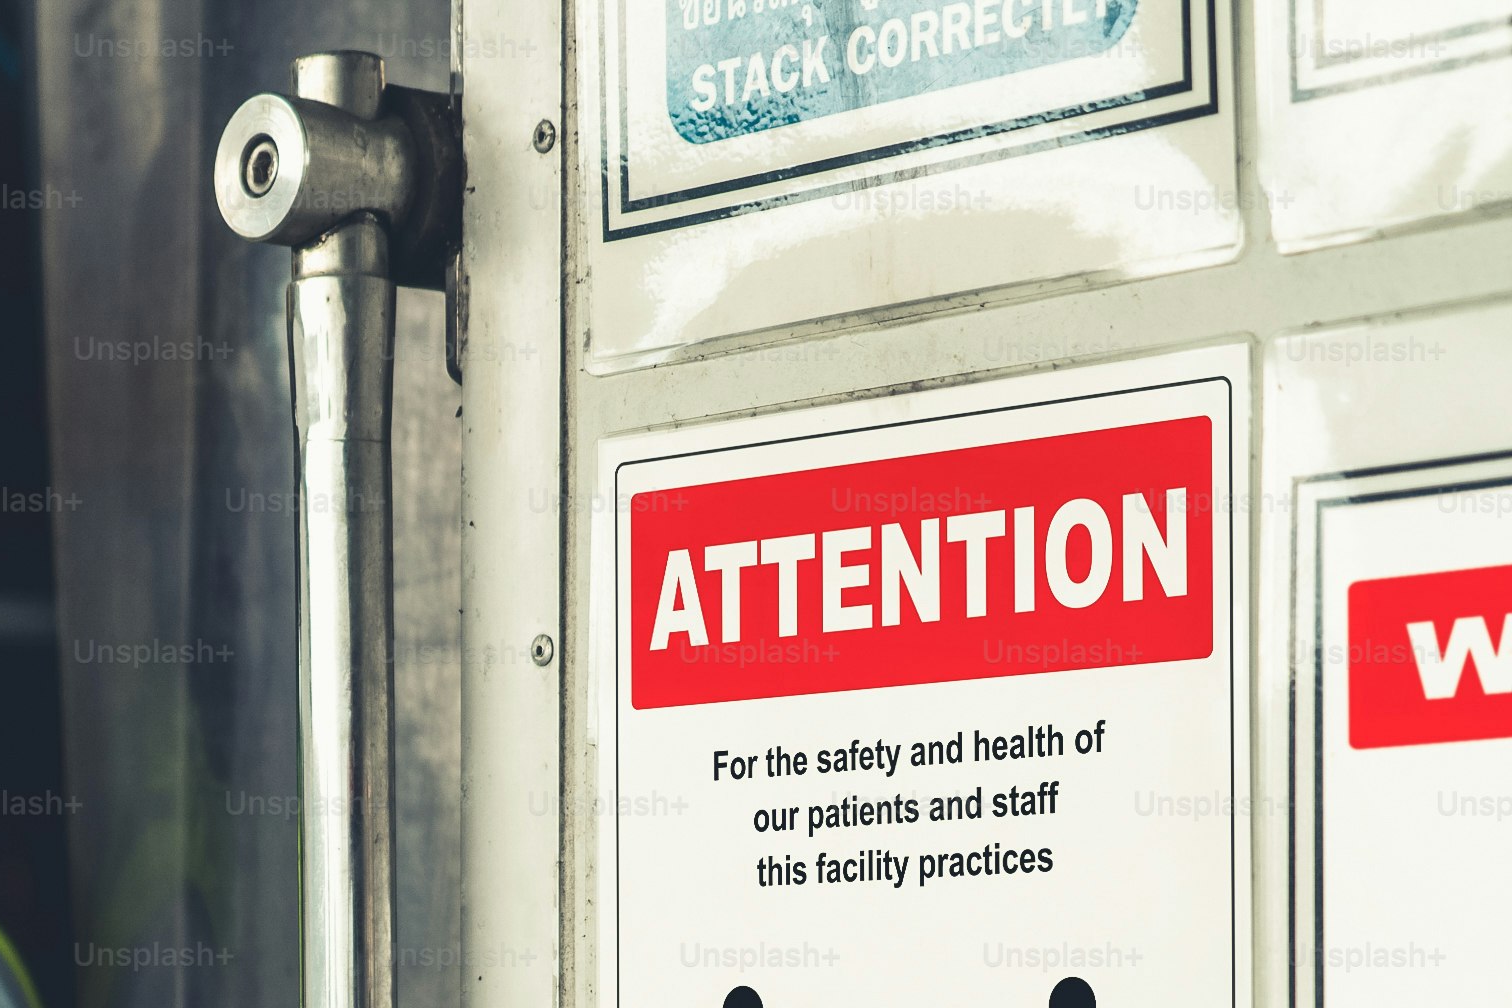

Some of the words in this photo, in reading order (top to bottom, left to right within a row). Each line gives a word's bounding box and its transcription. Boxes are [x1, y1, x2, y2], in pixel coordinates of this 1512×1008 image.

[690, 34, 831, 112] STACK
[649, 487, 1188, 651] ATTENTION
[713, 750, 758, 782] For
[766, 746, 808, 777] the
[816, 739, 902, 778] safety
[910, 731, 963, 767] and
[974, 724, 1064, 762] health
[1075, 719, 1106, 755] of
[753, 806, 800, 833] our
[808, 795, 920, 838] patients
[929, 787, 982, 822] and
[991, 780, 1060, 818] staff
[756, 854, 807, 887] this
[815, 849, 910, 889] facility
[919, 842, 1054, 887] practices
